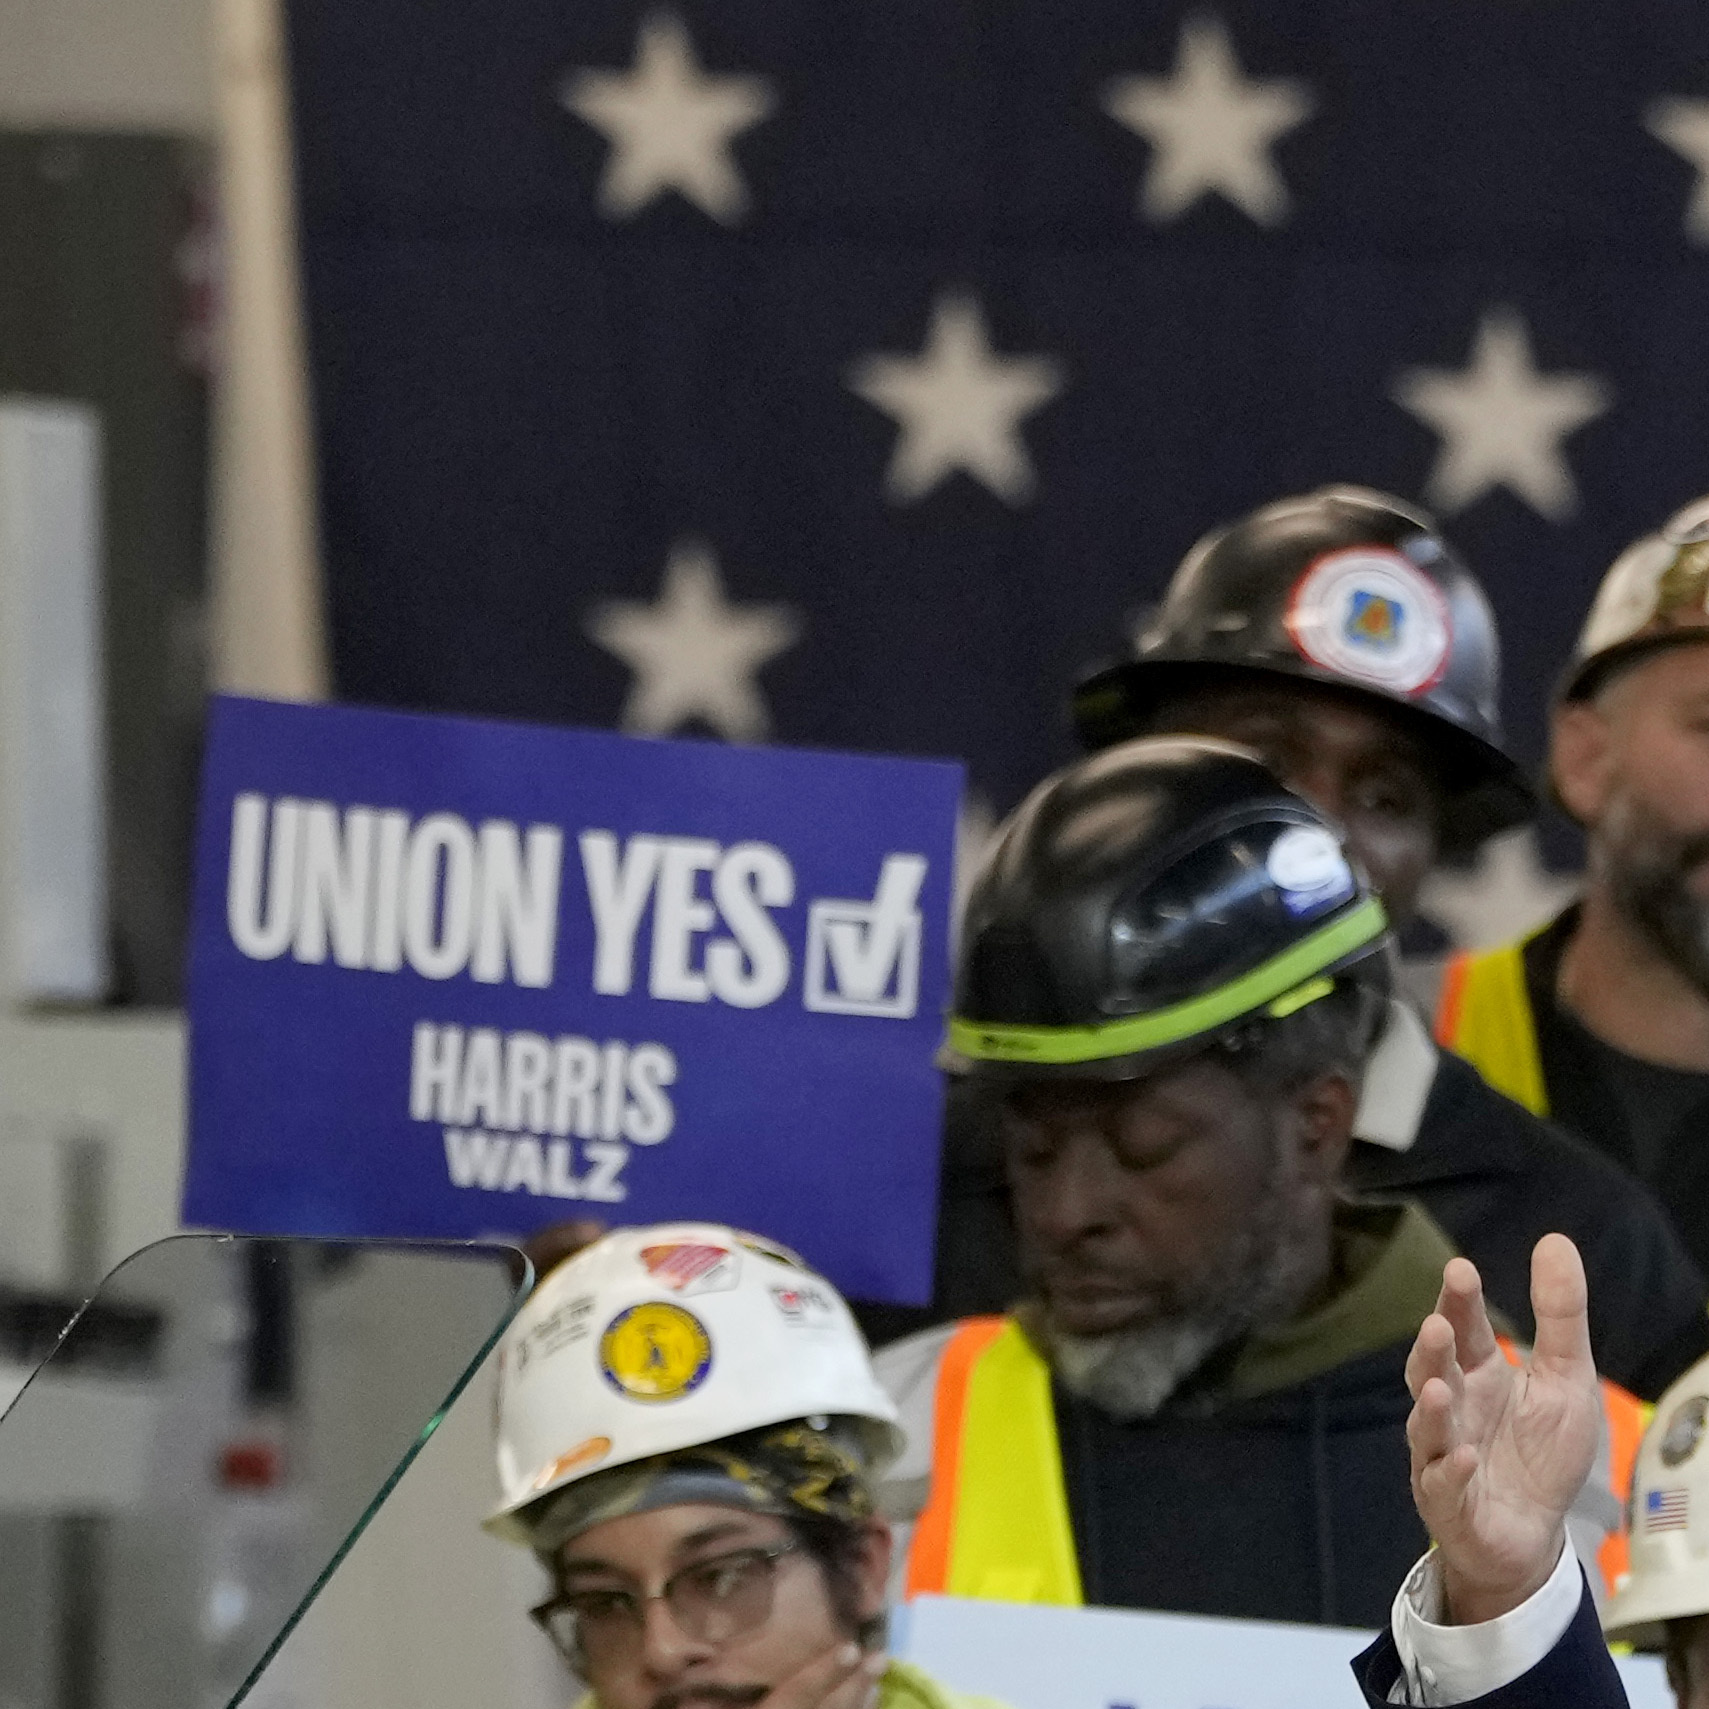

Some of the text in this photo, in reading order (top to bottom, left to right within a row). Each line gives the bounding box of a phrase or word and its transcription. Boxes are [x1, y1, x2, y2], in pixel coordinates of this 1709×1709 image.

[227, 793, 796, 1010] UNION YES
[410, 1022, 677, 1145] HARRIS
[443, 1128, 629, 1203] WALZ
